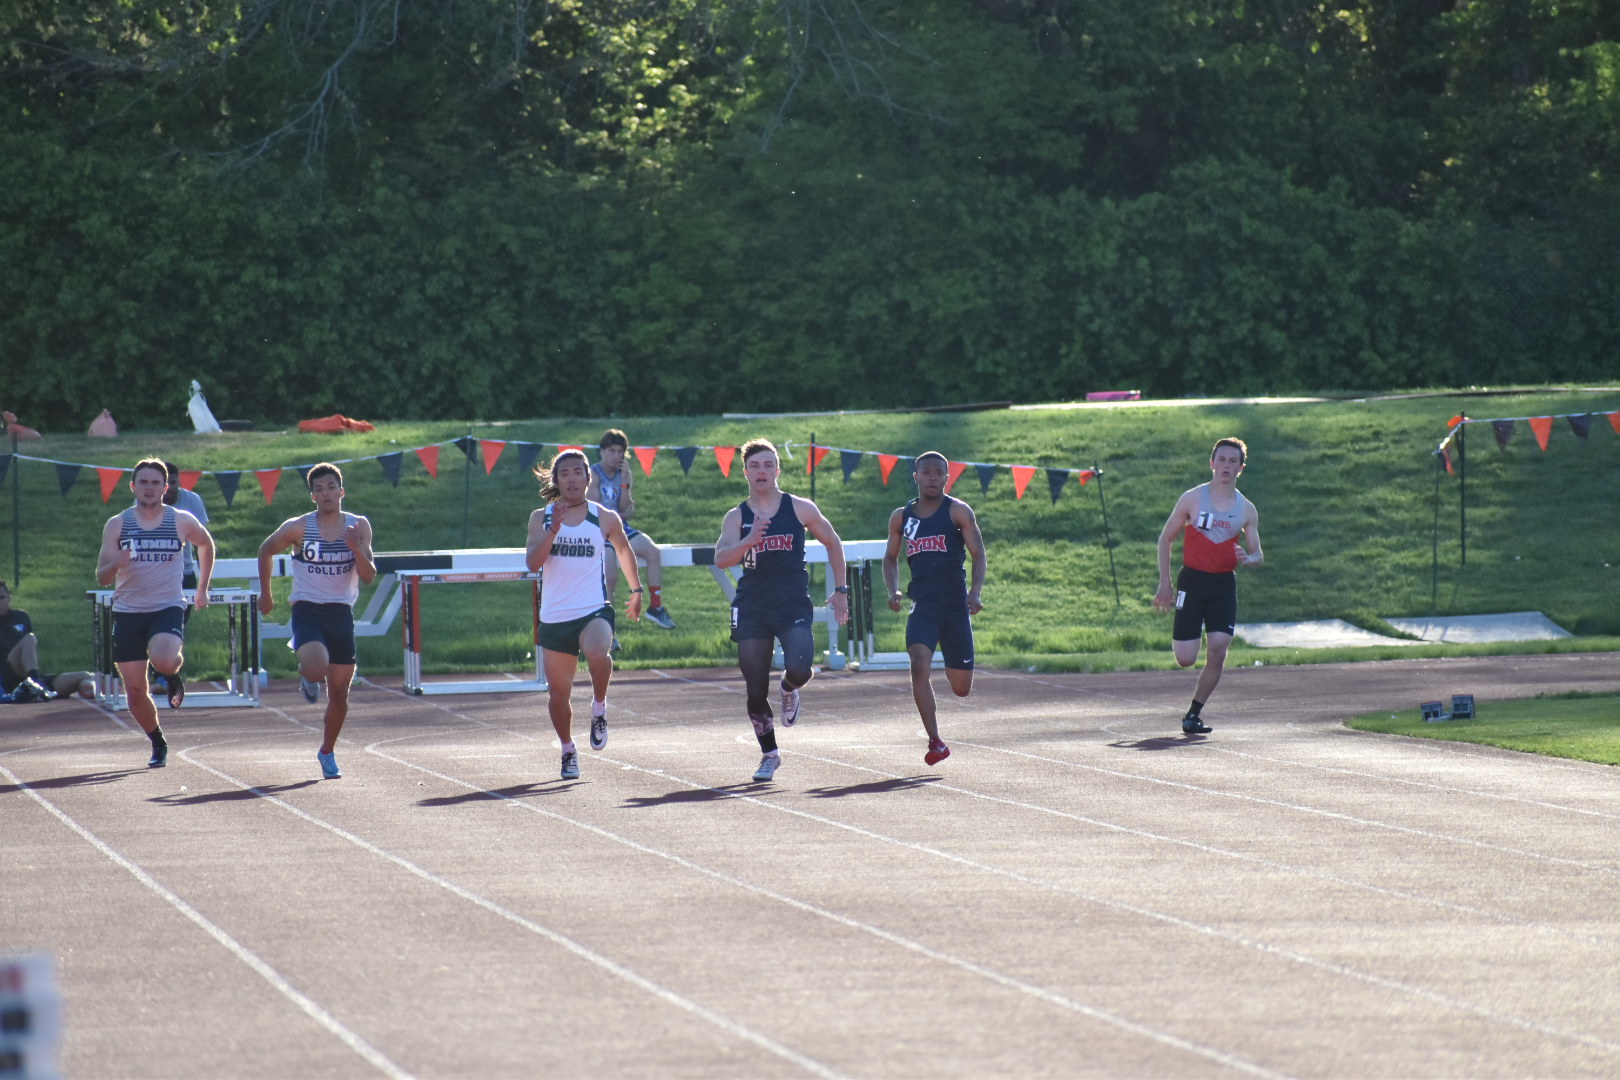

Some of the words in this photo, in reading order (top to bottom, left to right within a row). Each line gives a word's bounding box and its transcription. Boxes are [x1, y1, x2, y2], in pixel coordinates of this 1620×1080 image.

[904, 518, 919, 537] 3
[1198, 512, 1210, 531] 1
[557, 536, 591, 545] ILLIAM
[755, 534, 794, 554] YON
[129, 553, 174, 562] OLLEGE
[305, 541, 316, 560] 6
[744, 547, 756, 568] 4
